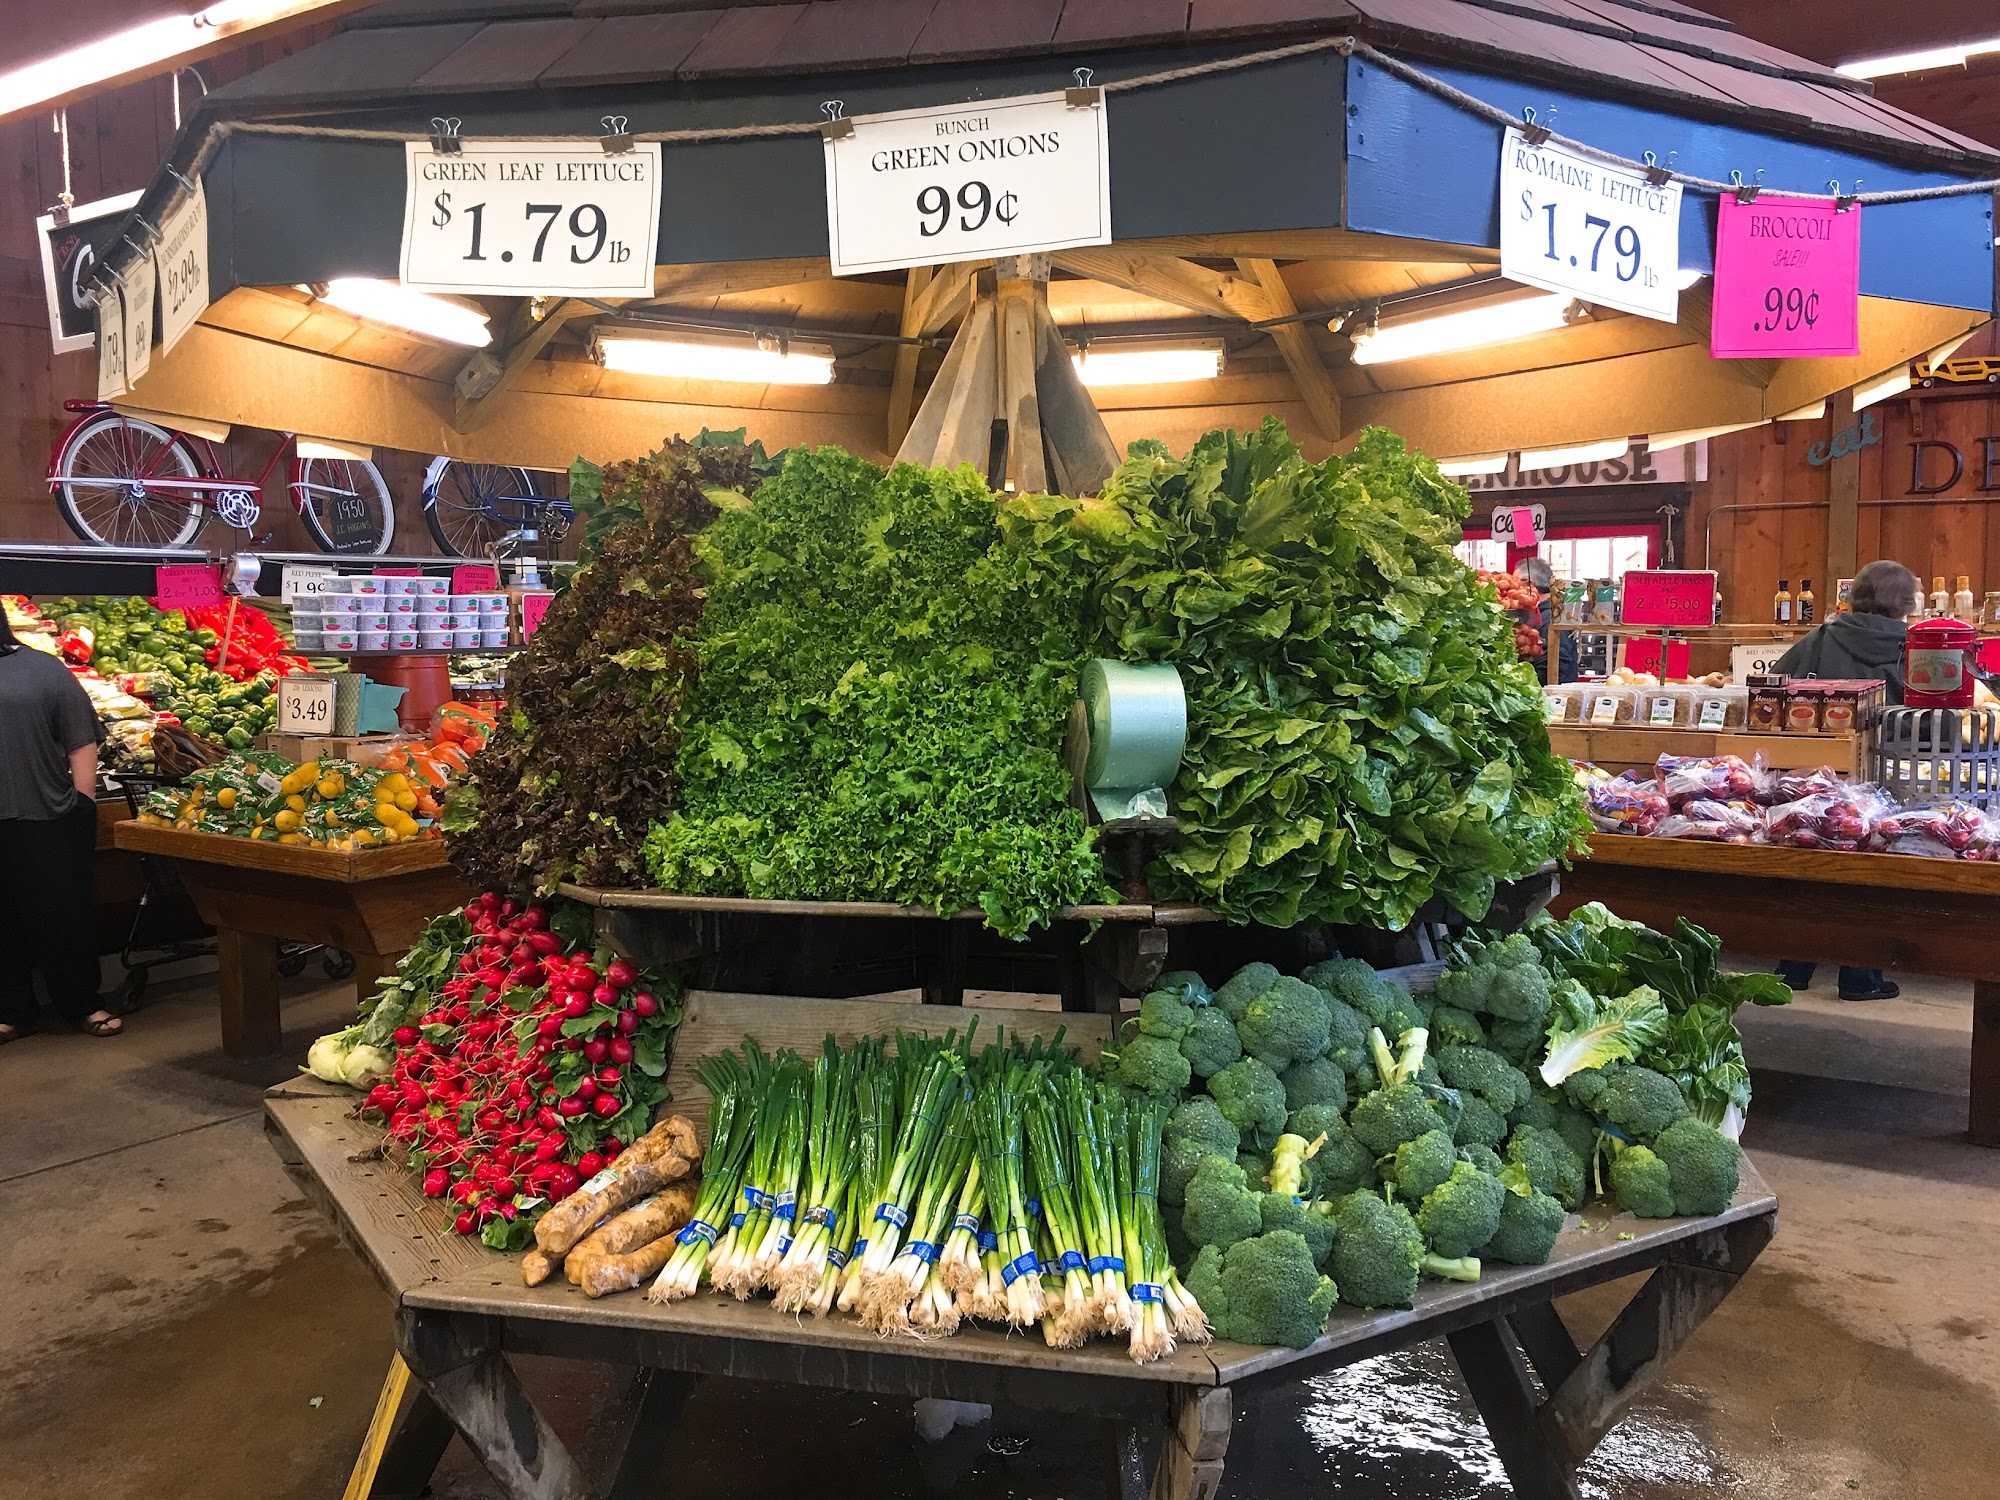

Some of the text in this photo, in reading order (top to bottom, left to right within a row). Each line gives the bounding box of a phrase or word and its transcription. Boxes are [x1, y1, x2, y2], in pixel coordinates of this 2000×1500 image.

[935, 117, 990, 137] BUNCH
[871, 131, 1060, 172] GREEN ONIONS
[423, 162, 645, 182] GREEN LEAF LETTUCE
[1515, 149, 1668, 215] ROMAINE LETTUCE
[916, 180, 1020, 237] 99¢
[1750, 215, 1832, 241] BROCCOLI
[1753, 286, 1820, 332] .99¢
[1807, 410, 1884, 467] eat
[336, 498, 365, 520] 1950
[1494, 513, 1544, 534] Cld
[1681, 576, 1707, 586] BAGS
[163, 587, 172, 599] 2
[1635, 597, 1646, 609] 2
[301, 684, 323, 693] LEMONS
[285, 695, 328, 721] $3.49
